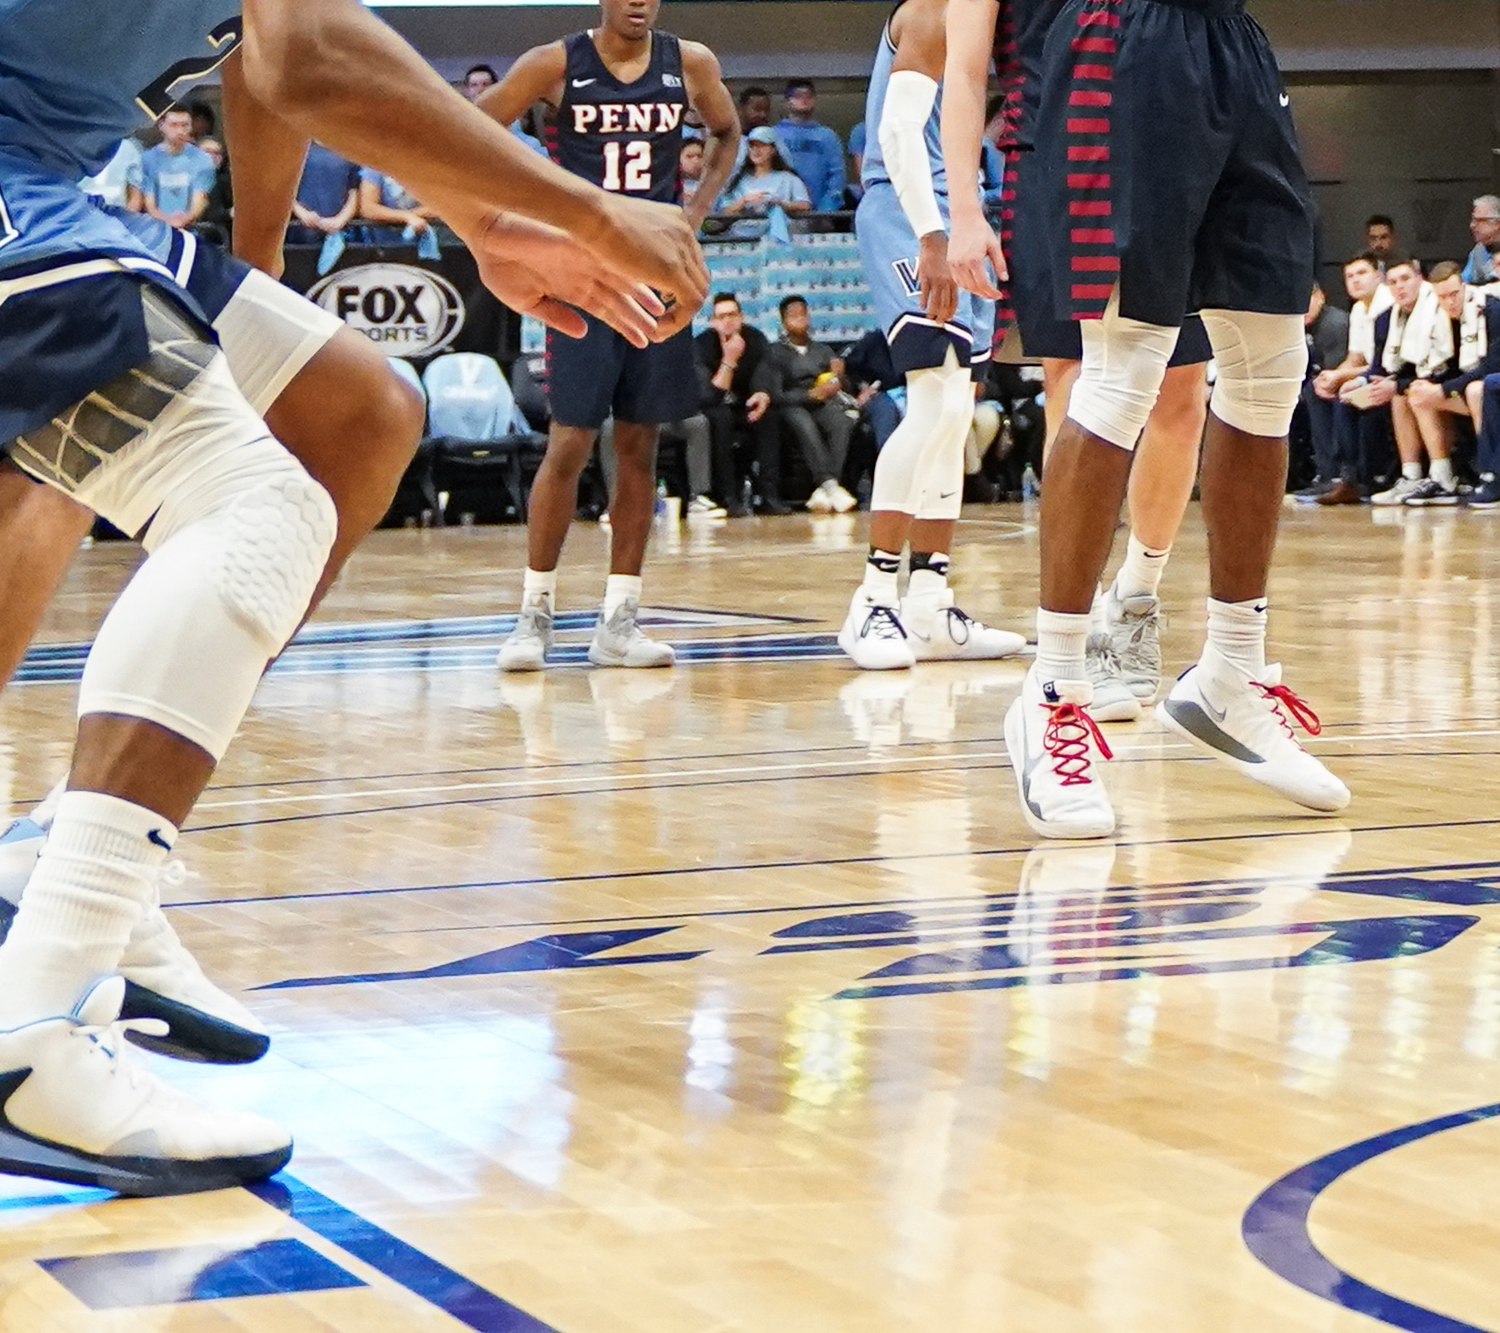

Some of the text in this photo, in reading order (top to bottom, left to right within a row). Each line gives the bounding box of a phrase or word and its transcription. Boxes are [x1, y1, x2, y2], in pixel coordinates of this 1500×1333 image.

[571, 102, 684, 133] PENN
[602, 140, 652, 192] 12
[336, 284, 427, 324] FOX
